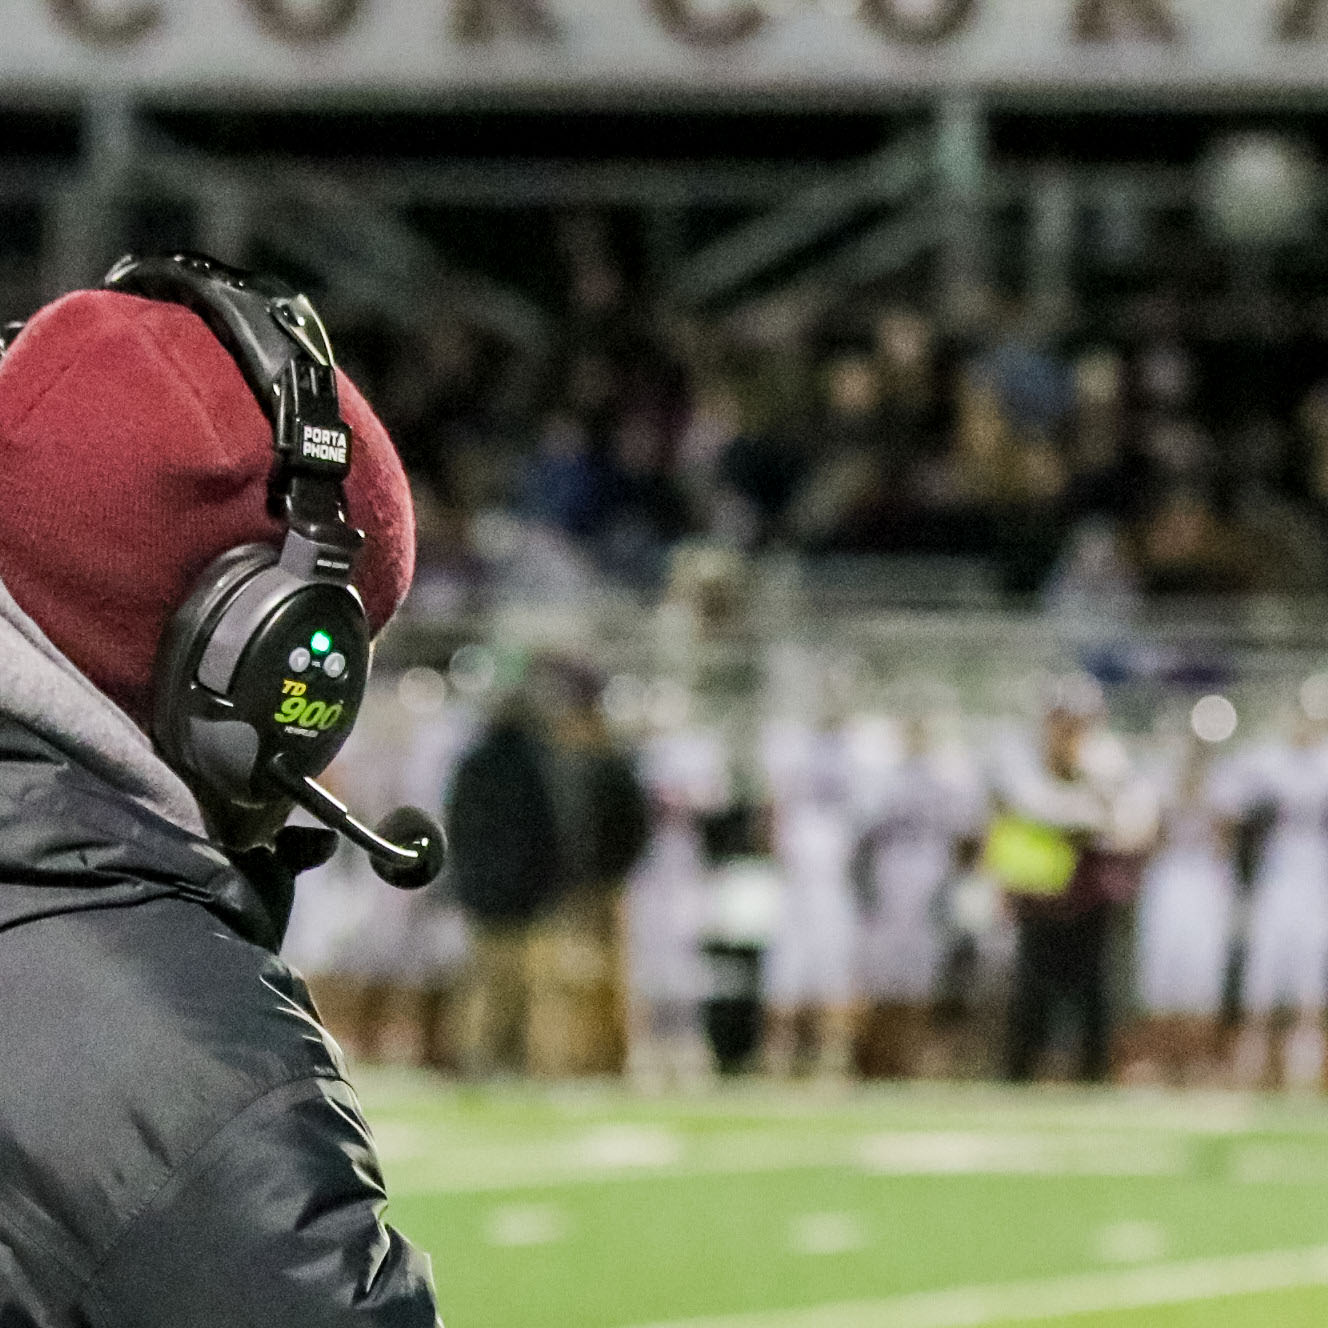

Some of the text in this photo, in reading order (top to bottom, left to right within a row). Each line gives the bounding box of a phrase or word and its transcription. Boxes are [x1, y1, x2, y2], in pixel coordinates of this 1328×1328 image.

[303, 424, 347, 448] PORTA
[302, 441, 347, 464] PHONE
[281, 679, 307, 696] TD
[274, 697, 343, 731] 900
